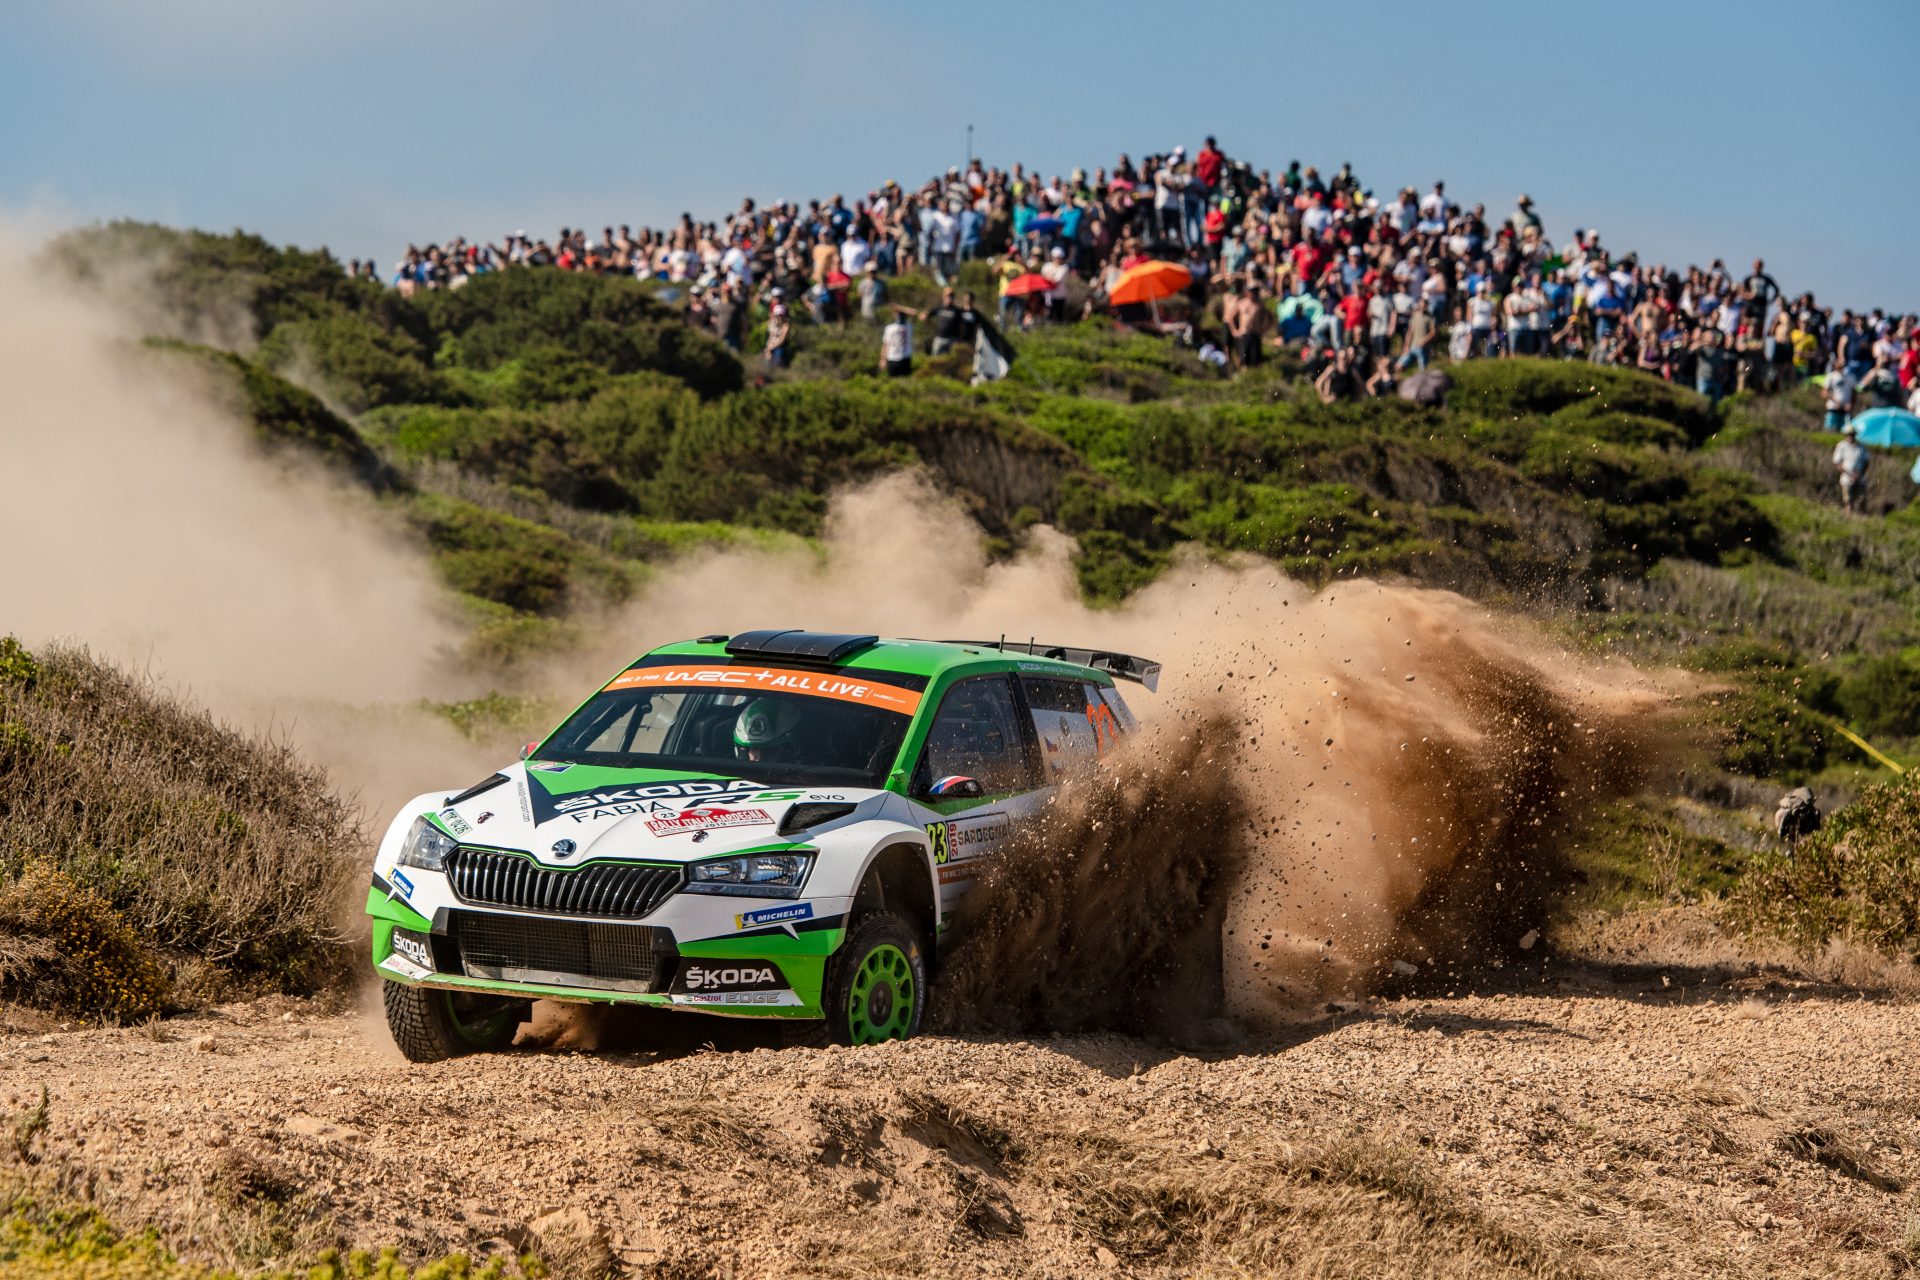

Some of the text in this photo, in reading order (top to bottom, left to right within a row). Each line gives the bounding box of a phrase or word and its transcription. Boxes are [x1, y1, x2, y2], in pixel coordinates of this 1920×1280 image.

[770, 675, 811, 689] ALL
[817, 680, 868, 698] LIVE
[553, 780, 770, 813] ŠKODA
[570, 801, 673, 823] FABIA
[684, 791, 806, 808] R5
[650, 819, 682, 831] RALLY
[682, 817, 714, 828] ITALIA
[714, 809, 765, 823] SARDEGNA
[949, 823, 959, 857] 2019
[957, 824, 1008, 846] SARDEGNA
[757, 908, 806, 922] MICHELIN
[393, 931, 428, 957] ŠKODA
[686, 966, 775, 986] ŠKODA
[693, 992, 781, 1004] Castrol EDGE
